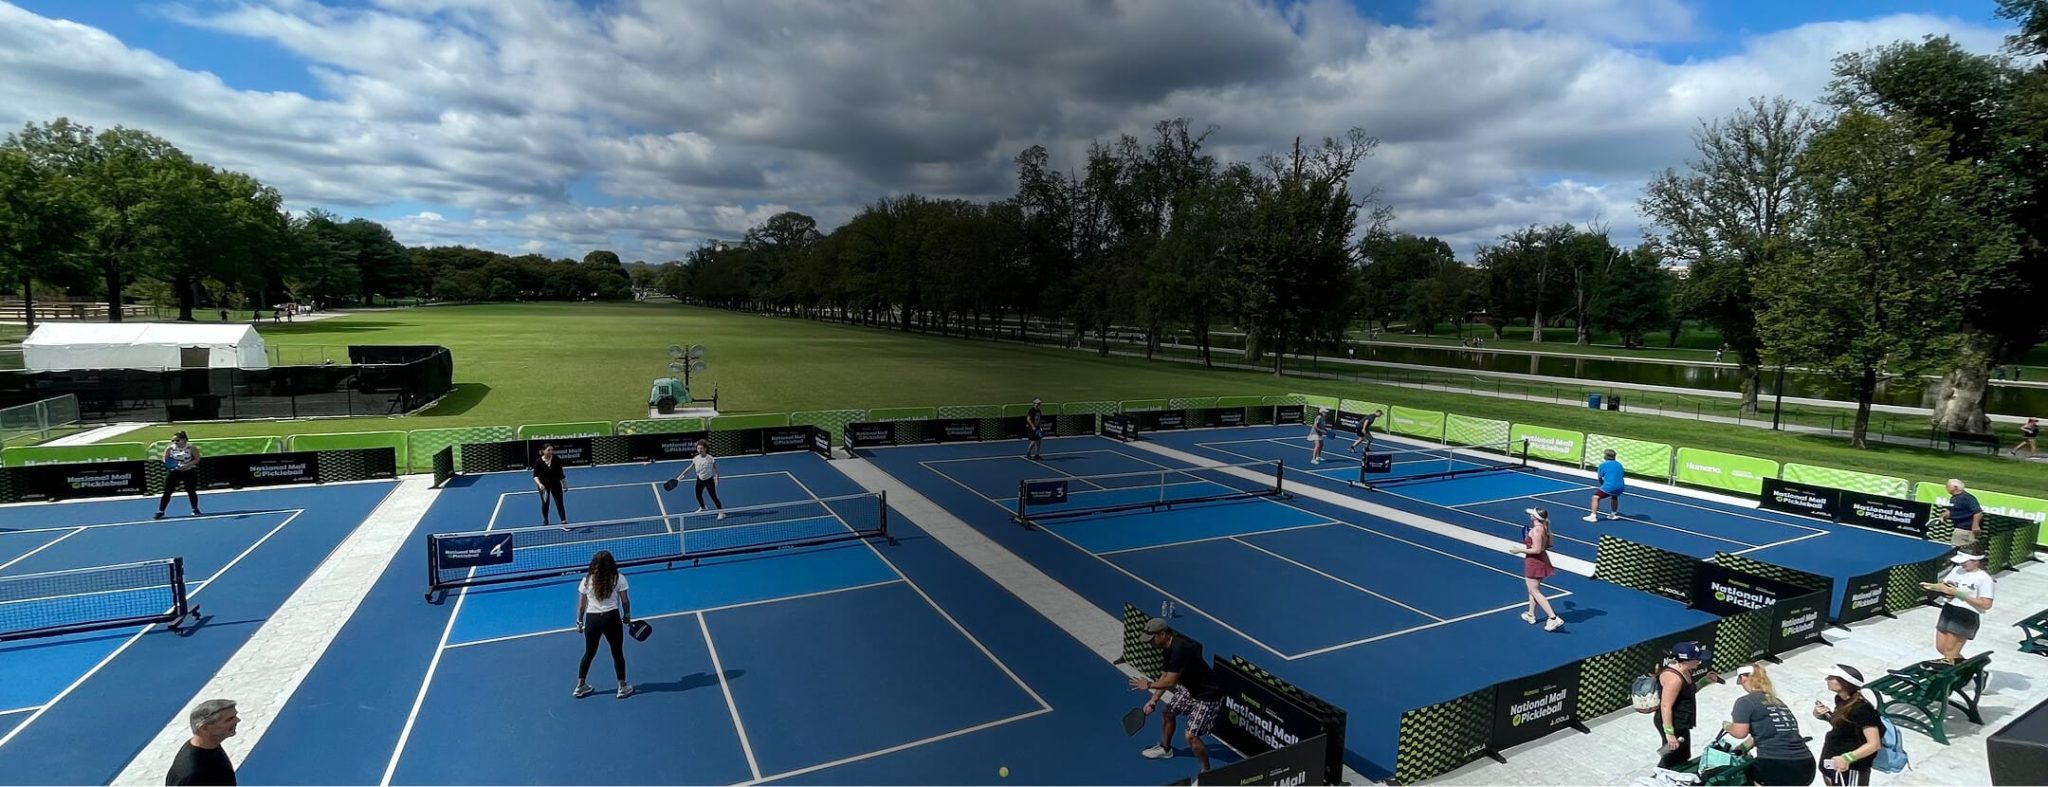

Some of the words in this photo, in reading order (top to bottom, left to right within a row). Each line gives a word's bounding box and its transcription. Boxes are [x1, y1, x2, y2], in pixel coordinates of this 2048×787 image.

[1686, 462, 1721, 473] Humana
[1056, 487, 1064, 498] 3
[1773, 490, 1808, 502] National
[1808, 496, 1827, 505] Mall
[1783, 497, 1823, 509] Pickleball
[1853, 503, 1893, 515] National
[1894, 510, 1916, 519] Mall
[1865, 511, 1912, 524] Pickleball
[490, 544, 504, 558] 4
[1664, 587, 1686, 597] JOOLA
[1711, 581, 1763, 603] National
[1781, 615, 1806, 628] National
[1805, 611, 1818, 621] Mall
[1789, 620, 1815, 635] Pickleball
[1510, 694, 1549, 716] National
[1548, 688, 1567, 704] Mall
[1225, 696, 1273, 733] National
[1521, 700, 1563, 724] Pickleball
[1554, 714, 1570, 725] JOOLA
[1468, 743, 1486, 755] JOOLA
[1280, 771, 1306, 786] Mall
